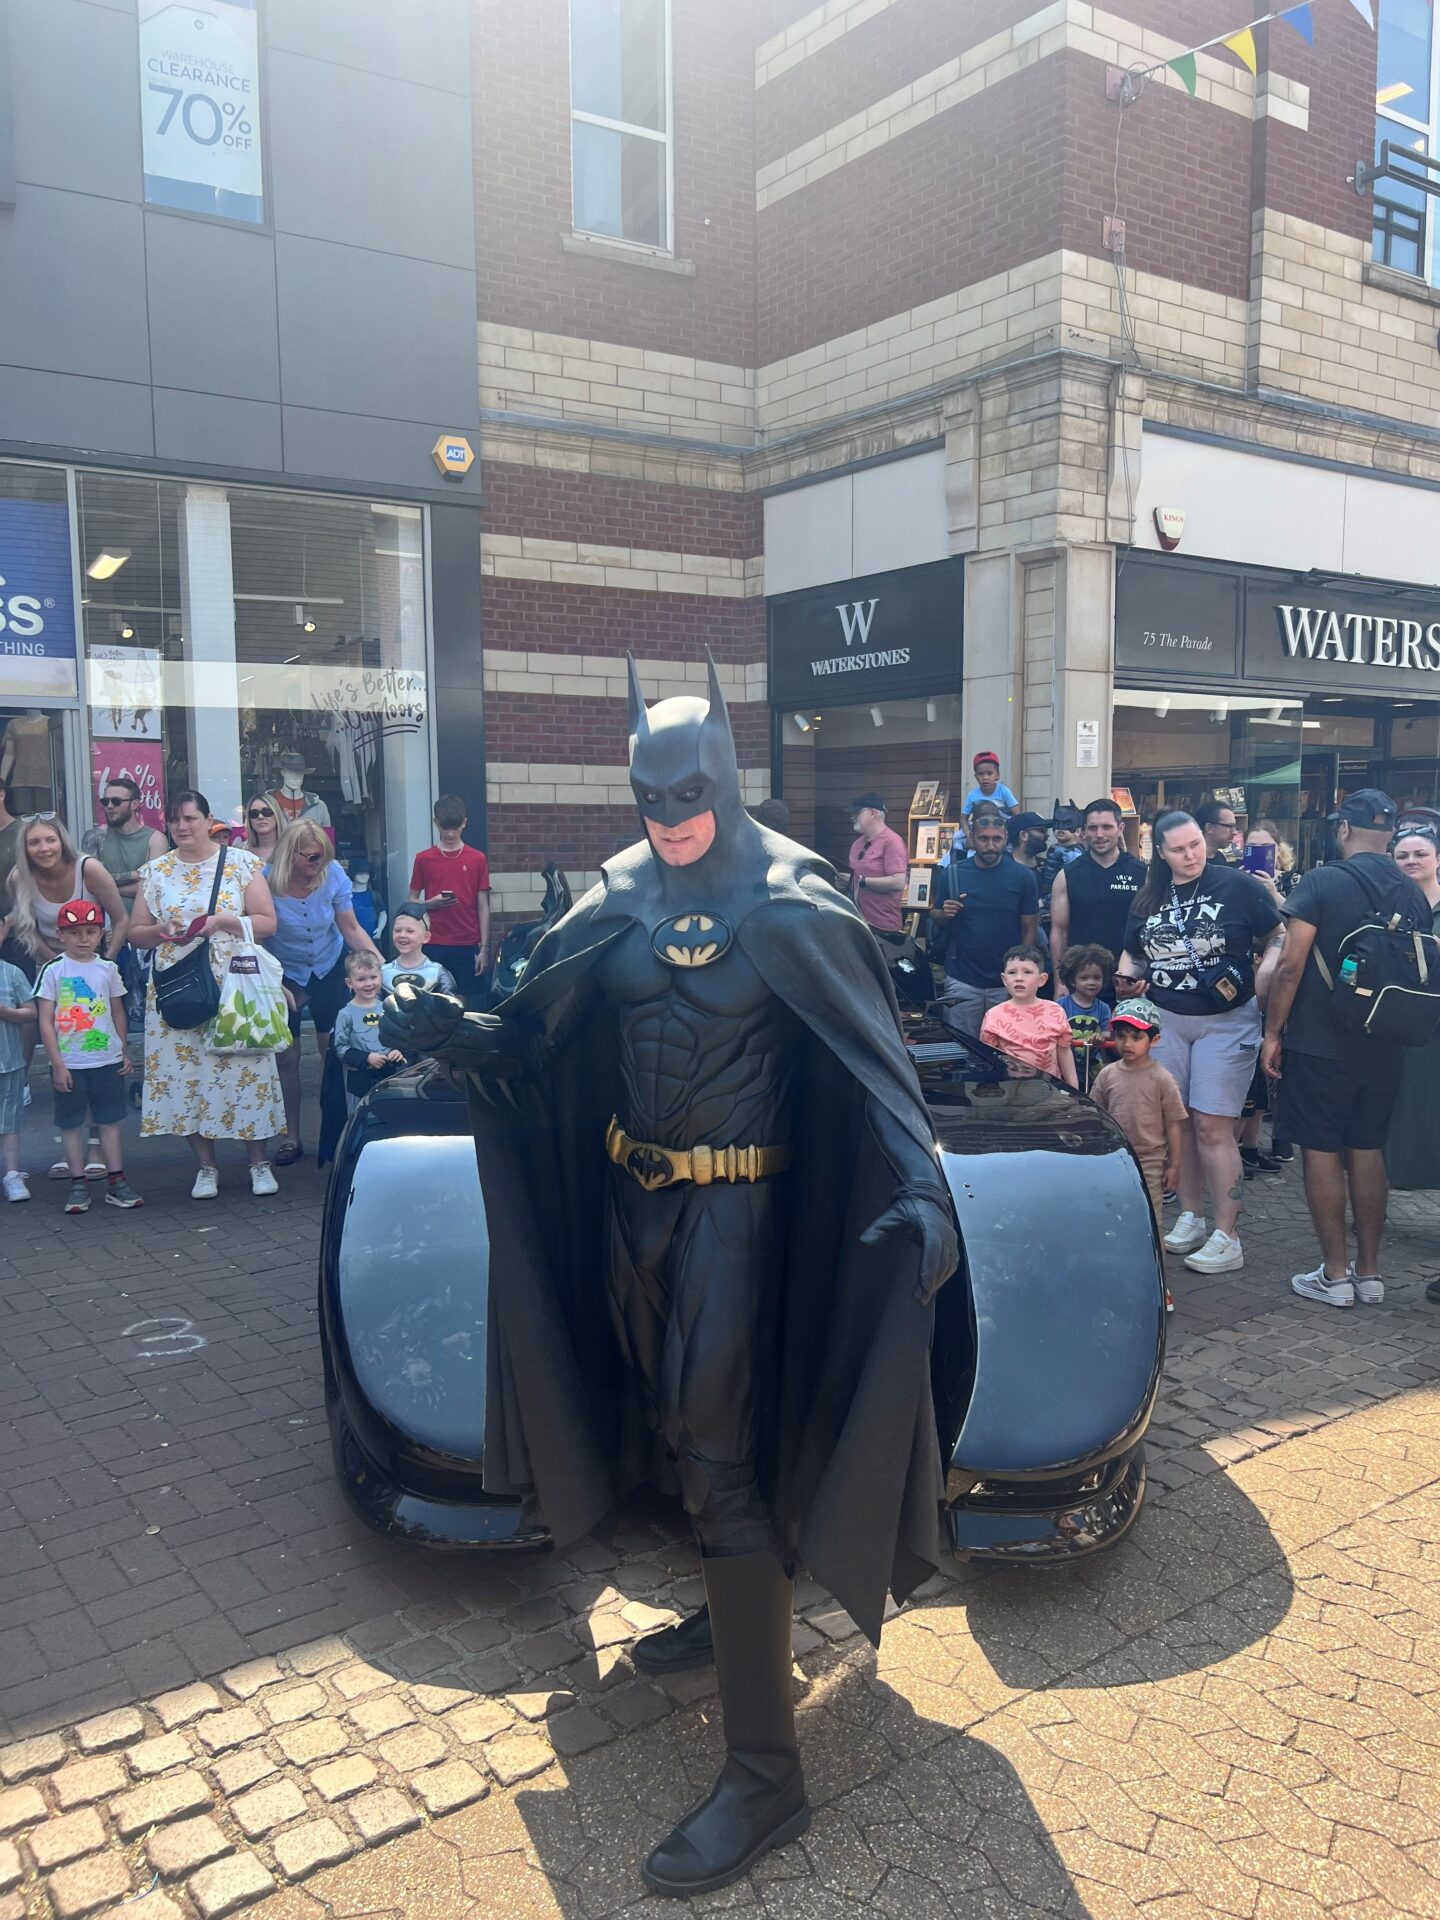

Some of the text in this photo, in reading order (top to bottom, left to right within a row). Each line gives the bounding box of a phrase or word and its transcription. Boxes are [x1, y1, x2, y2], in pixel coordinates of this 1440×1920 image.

[160, 49, 235, 75] WAREHOUSE
[147, 57, 251, 93] CLEARANCE
[148, 82, 252, 146] 70%
[222, 134, 252, 150] OFF
[447, 448, 465, 460] ADT
[1164, 513, 1184, 523] KINGS
[835, 598, 880, 646] W
[1143, 631, 1213, 651] 75 The Parade
[810, 647, 910, 677] WATERSTONES
[1110, 883, 1139, 891] PARADSE
